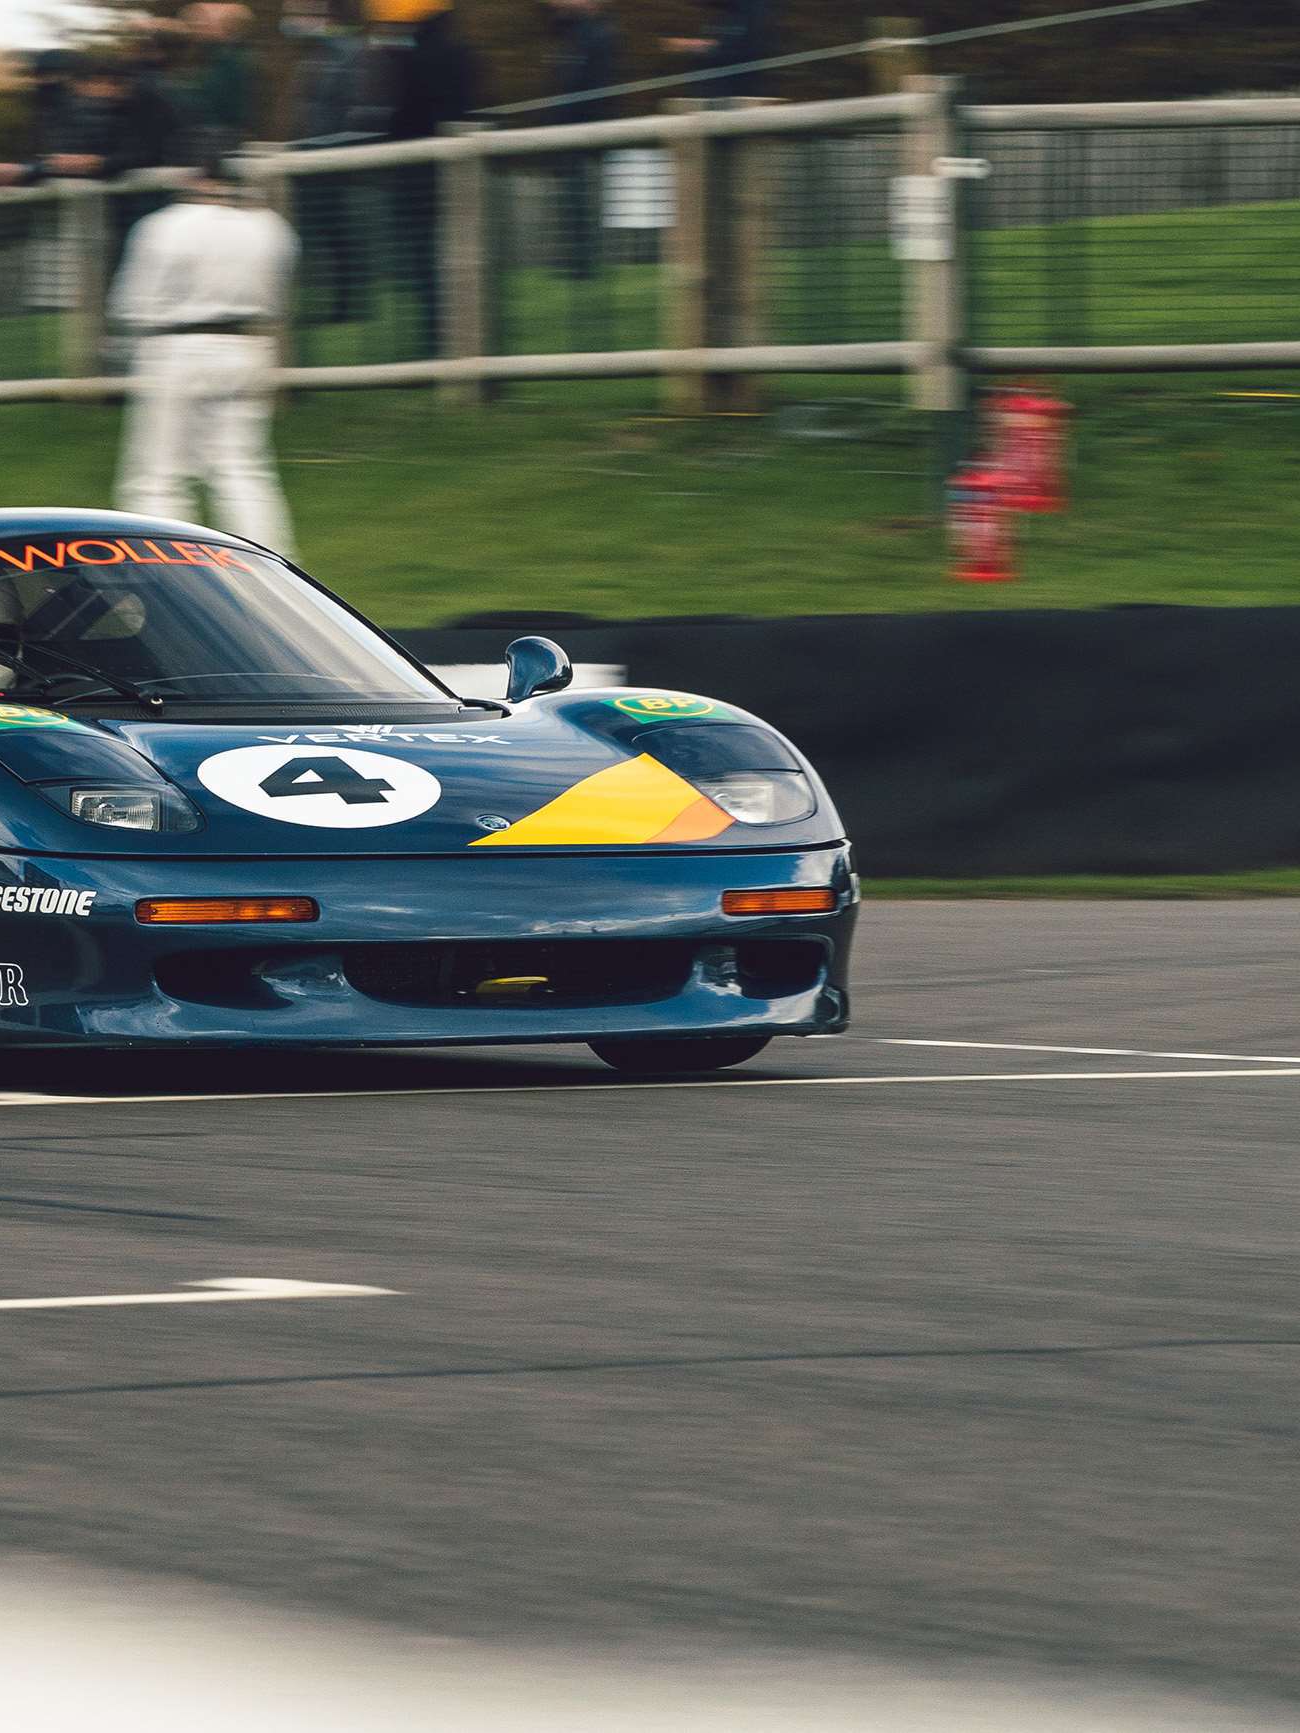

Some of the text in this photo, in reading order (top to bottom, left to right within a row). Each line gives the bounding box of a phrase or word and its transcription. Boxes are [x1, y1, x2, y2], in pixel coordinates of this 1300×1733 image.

[637, 697, 697, 710] BP
[257, 733, 512, 745] VERTEX
[258, 756, 396, 804] 4
